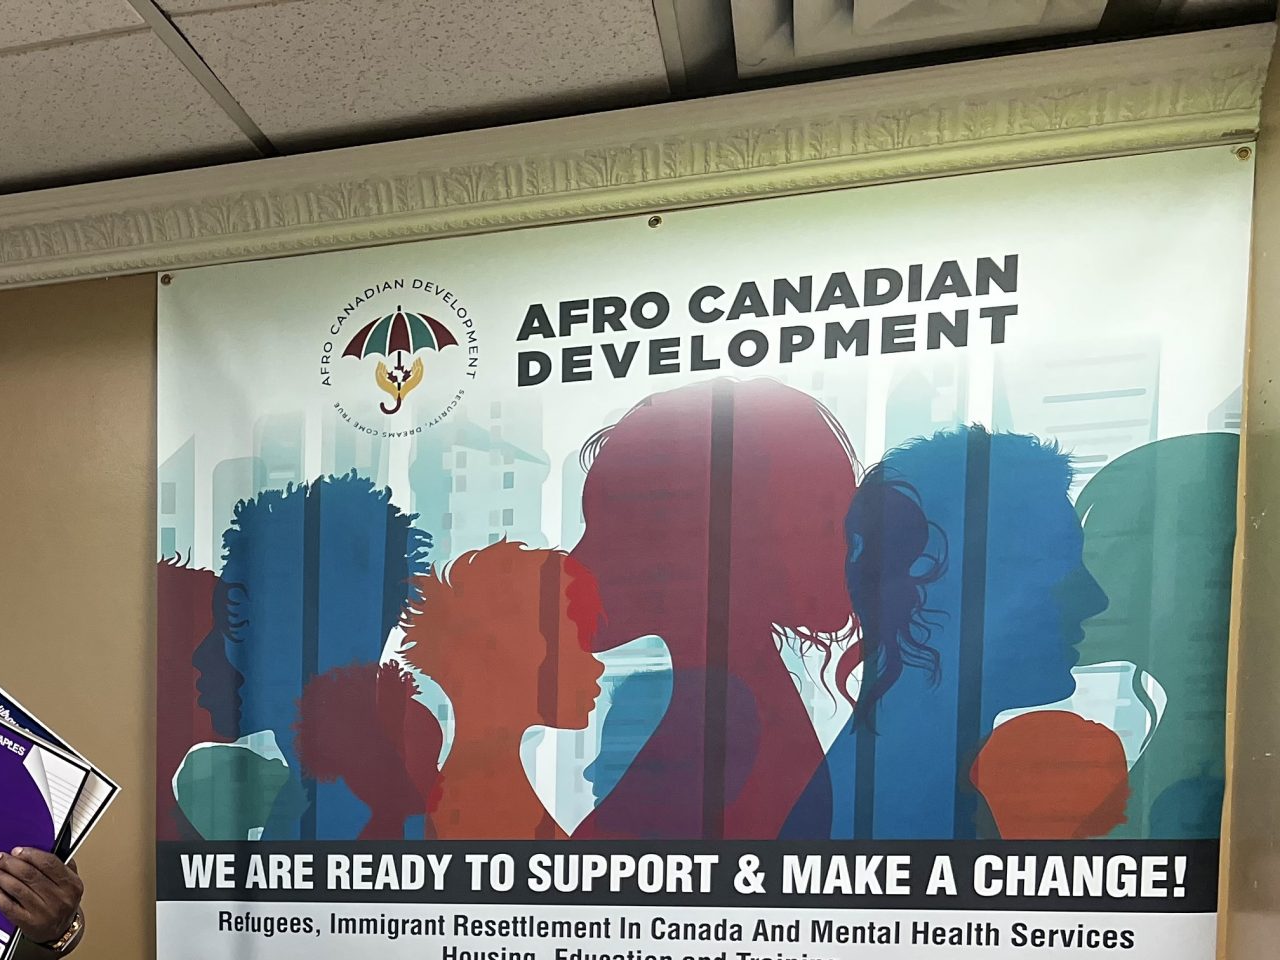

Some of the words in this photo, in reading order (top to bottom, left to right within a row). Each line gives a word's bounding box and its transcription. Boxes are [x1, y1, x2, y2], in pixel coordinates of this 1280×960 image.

[517, 289, 671, 341] AFRO
[688, 254, 1020, 324] CANADIAN
[320, 341, 333, 386] AFRO
[330, 279, 405, 335] CANADIAN
[412, 279, 479, 380] DEVELOPMENT
[517, 305, 1020, 388] DEVELOPMENT
[333, 401, 352, 423] TRUE
[181, 853, 235, 890] WE
[245, 854, 313, 890] ARE
[327, 854, 453, 892] READY
[466, 854, 515, 892] TO
[527, 854, 718, 894] SUPPORT
[733, 854, 767, 895] &
[782, 855, 911, 896] MAKE
[926, 855, 958, 896] A
[973, 855, 1188, 898] CHANGE!
[218, 911, 321, 938] Refugees,
[330, 913, 445, 938] Immigrant
[454, 915, 611, 940] Resettlement
[620, 918, 641, 940] In
[650, 917, 743, 942] Canada
[752, 919, 801, 943] And
[810, 920, 900, 945] Mental
[911, 922, 1001, 947] Health
[1011, 924, 1136, 949] Services
